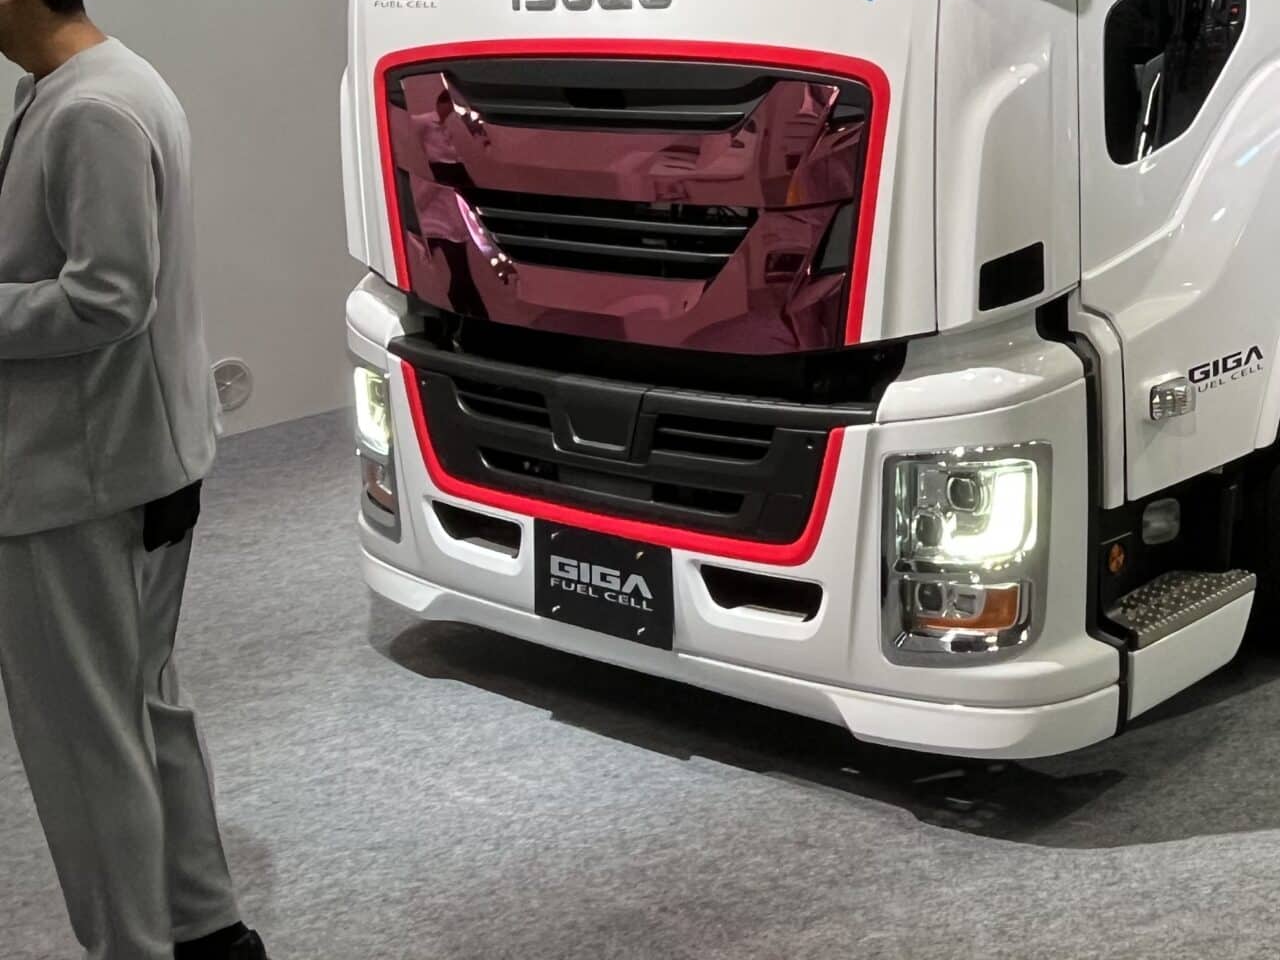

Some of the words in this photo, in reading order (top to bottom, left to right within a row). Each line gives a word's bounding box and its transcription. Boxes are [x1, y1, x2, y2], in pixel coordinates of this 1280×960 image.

[1189, 346, 1263, 383] GIGA
[1198, 378, 1225, 393] UEL
[1231, 364, 1263, 380] CELL
[550, 554, 653, 599] GIGA
[551, 577, 598, 598] FUEL
[604, 591, 653, 612] CELL
